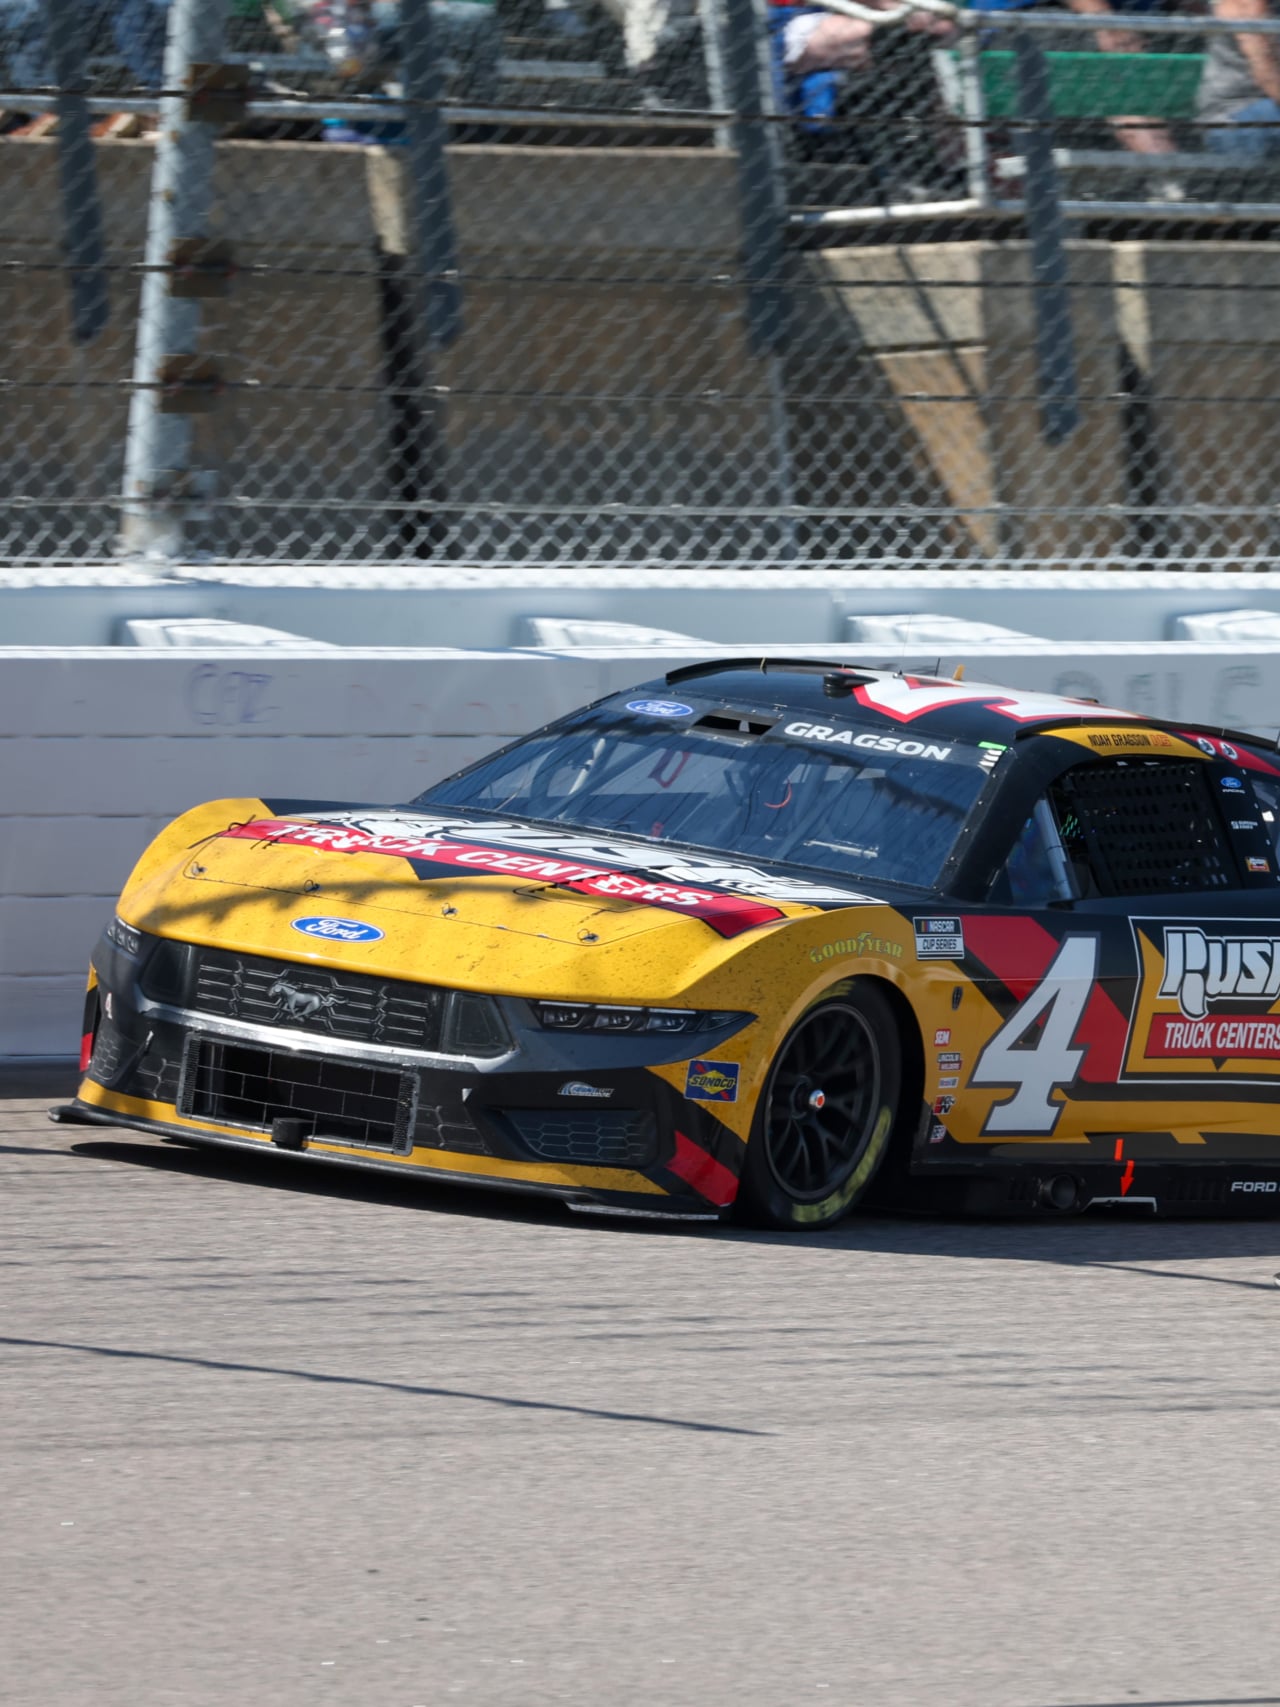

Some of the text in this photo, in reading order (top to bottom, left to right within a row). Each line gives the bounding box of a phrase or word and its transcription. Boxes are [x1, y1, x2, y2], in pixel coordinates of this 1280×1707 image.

[784, 721, 953, 762] GRAGSON
[1087, 734, 1111, 747] NOAH
[1112, 735, 1151, 748] GRAGSON
[455, 850, 714, 906] CENTERS
[306, 918, 369, 941] Ford
[928, 920, 956, 933] NASCAR
[809, 933, 903, 964] GOODYEAR
[922, 938, 958, 950] CUP SERIES
[969, 935, 1098, 1133] 4
[1164, 1022, 1217, 1049] TRUCK
[690, 1075, 736, 1089] SUNOCO
[1231, 1181, 1277, 1193] FORD
